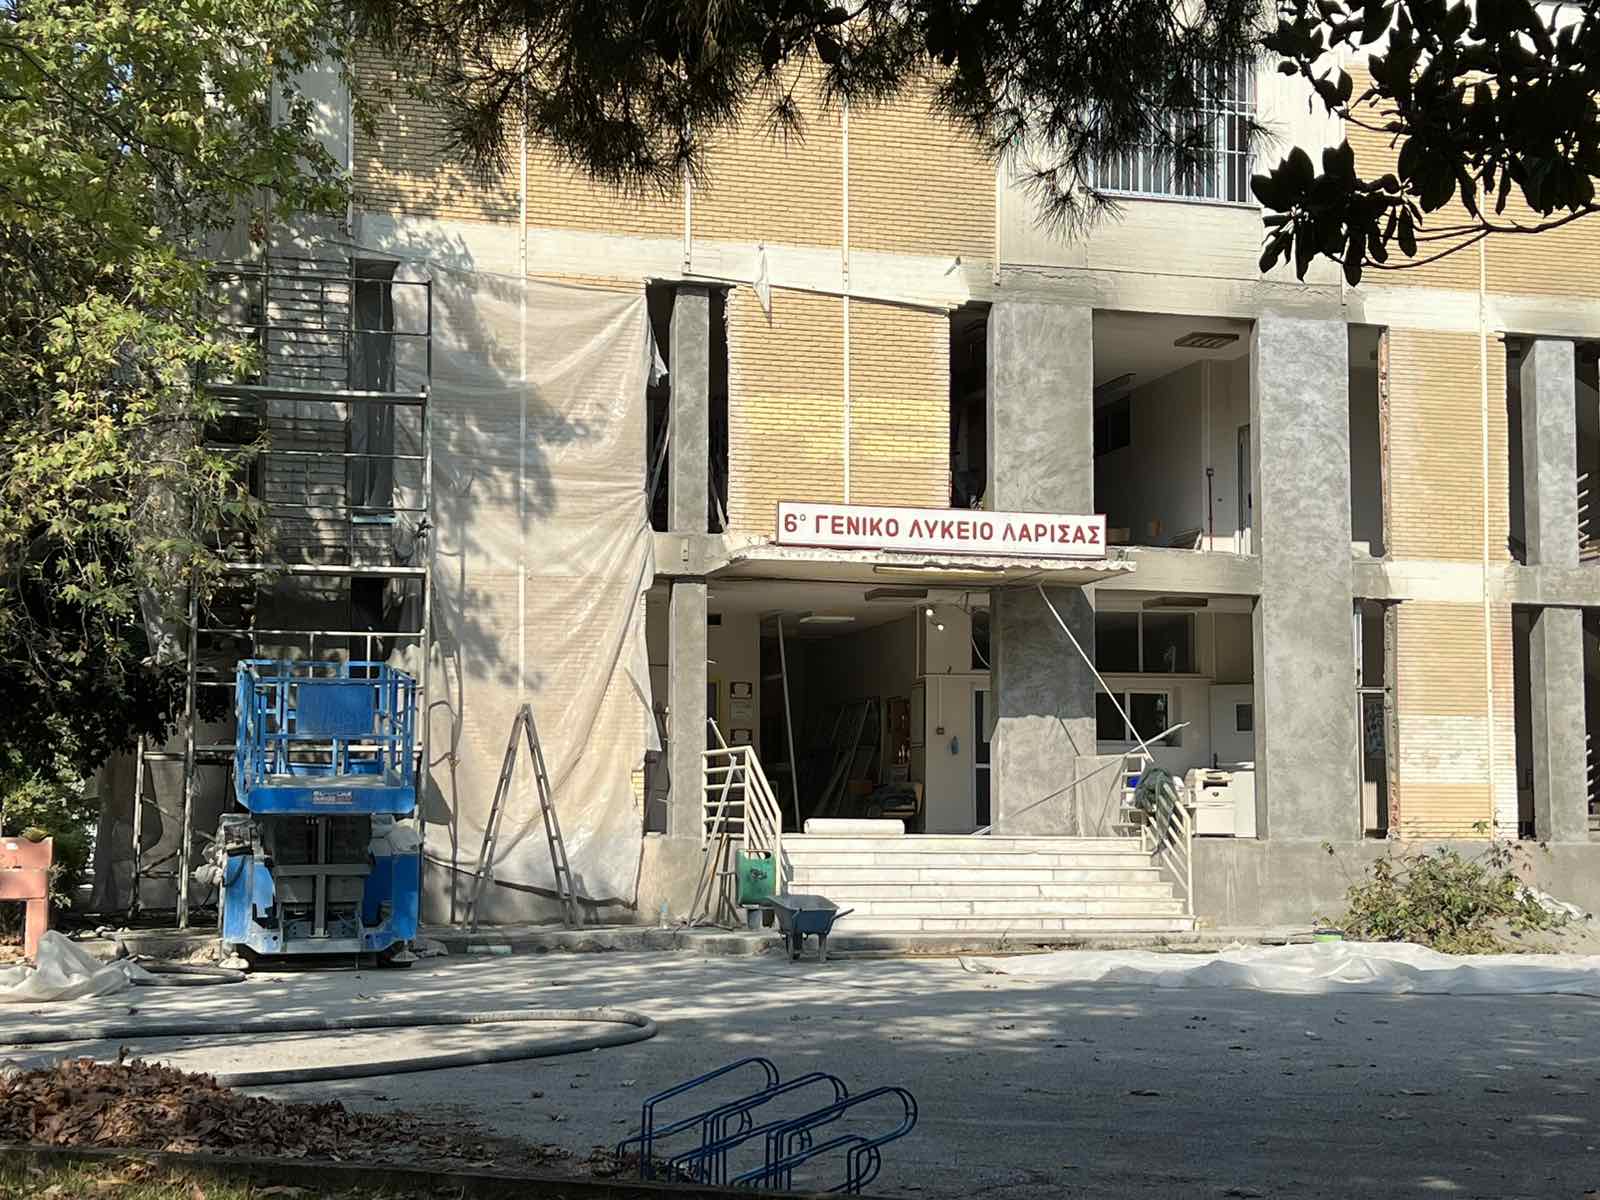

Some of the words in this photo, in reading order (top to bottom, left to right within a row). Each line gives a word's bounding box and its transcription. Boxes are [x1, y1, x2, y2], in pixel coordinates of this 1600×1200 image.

[815, 514, 900, 536] ΓΕΝΙΚΟ
[908, 519, 994, 541] ΛΥΚΕΙΟ
[1002, 523, 1101, 545] ΛΑΡΙΣΑΣ
